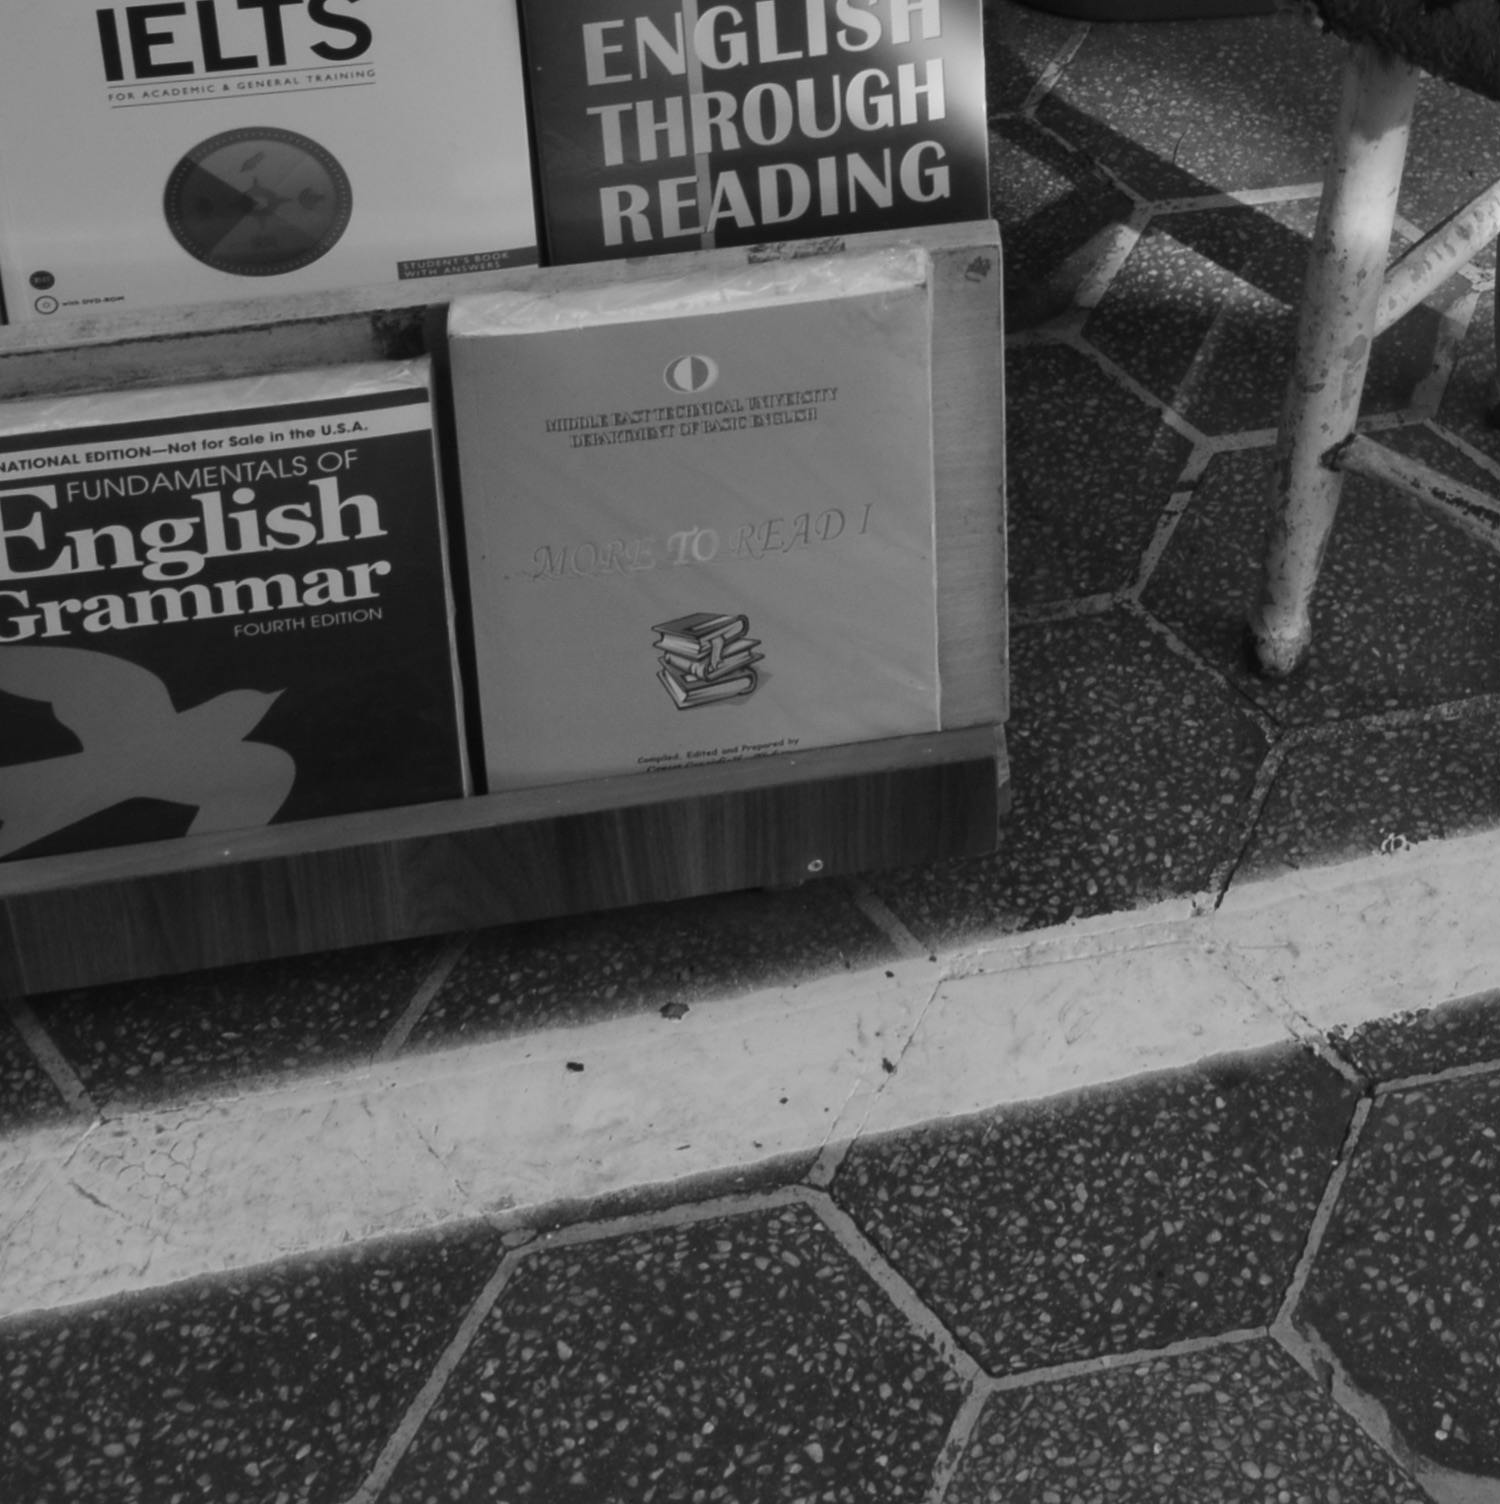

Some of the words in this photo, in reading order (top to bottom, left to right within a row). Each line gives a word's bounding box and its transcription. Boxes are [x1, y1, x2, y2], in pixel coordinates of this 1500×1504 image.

[107, 90, 136, 104] FOR
[141, 83, 216, 101] ACADEMIC
[236, 75, 302, 92] GENERAL
[305, 68, 377, 86] TRAINING
[585, 57, 947, 167] THROUGH
[598, 139, 952, 248] READING
[200, 435, 226, 451] for
[229, 429, 266, 449] Sale
[269, 429, 286, 444] in
[287, 424, 317, 442] the
[320, 420, 370, 438] U.S.A.
[65, 454, 309, 505] FUNDAMENTALS
[316, 448, 361, 471] OF
[0, 475, 390, 584] English
[532, 538, 658, 582] MORE
[665, 524, 721, 566] TO
[728, 505, 847, 562] READ
[0, 558, 393, 645] Grammar
[232, 616, 306, 639] FOURTH
[309, 606, 384, 630] EDITION
